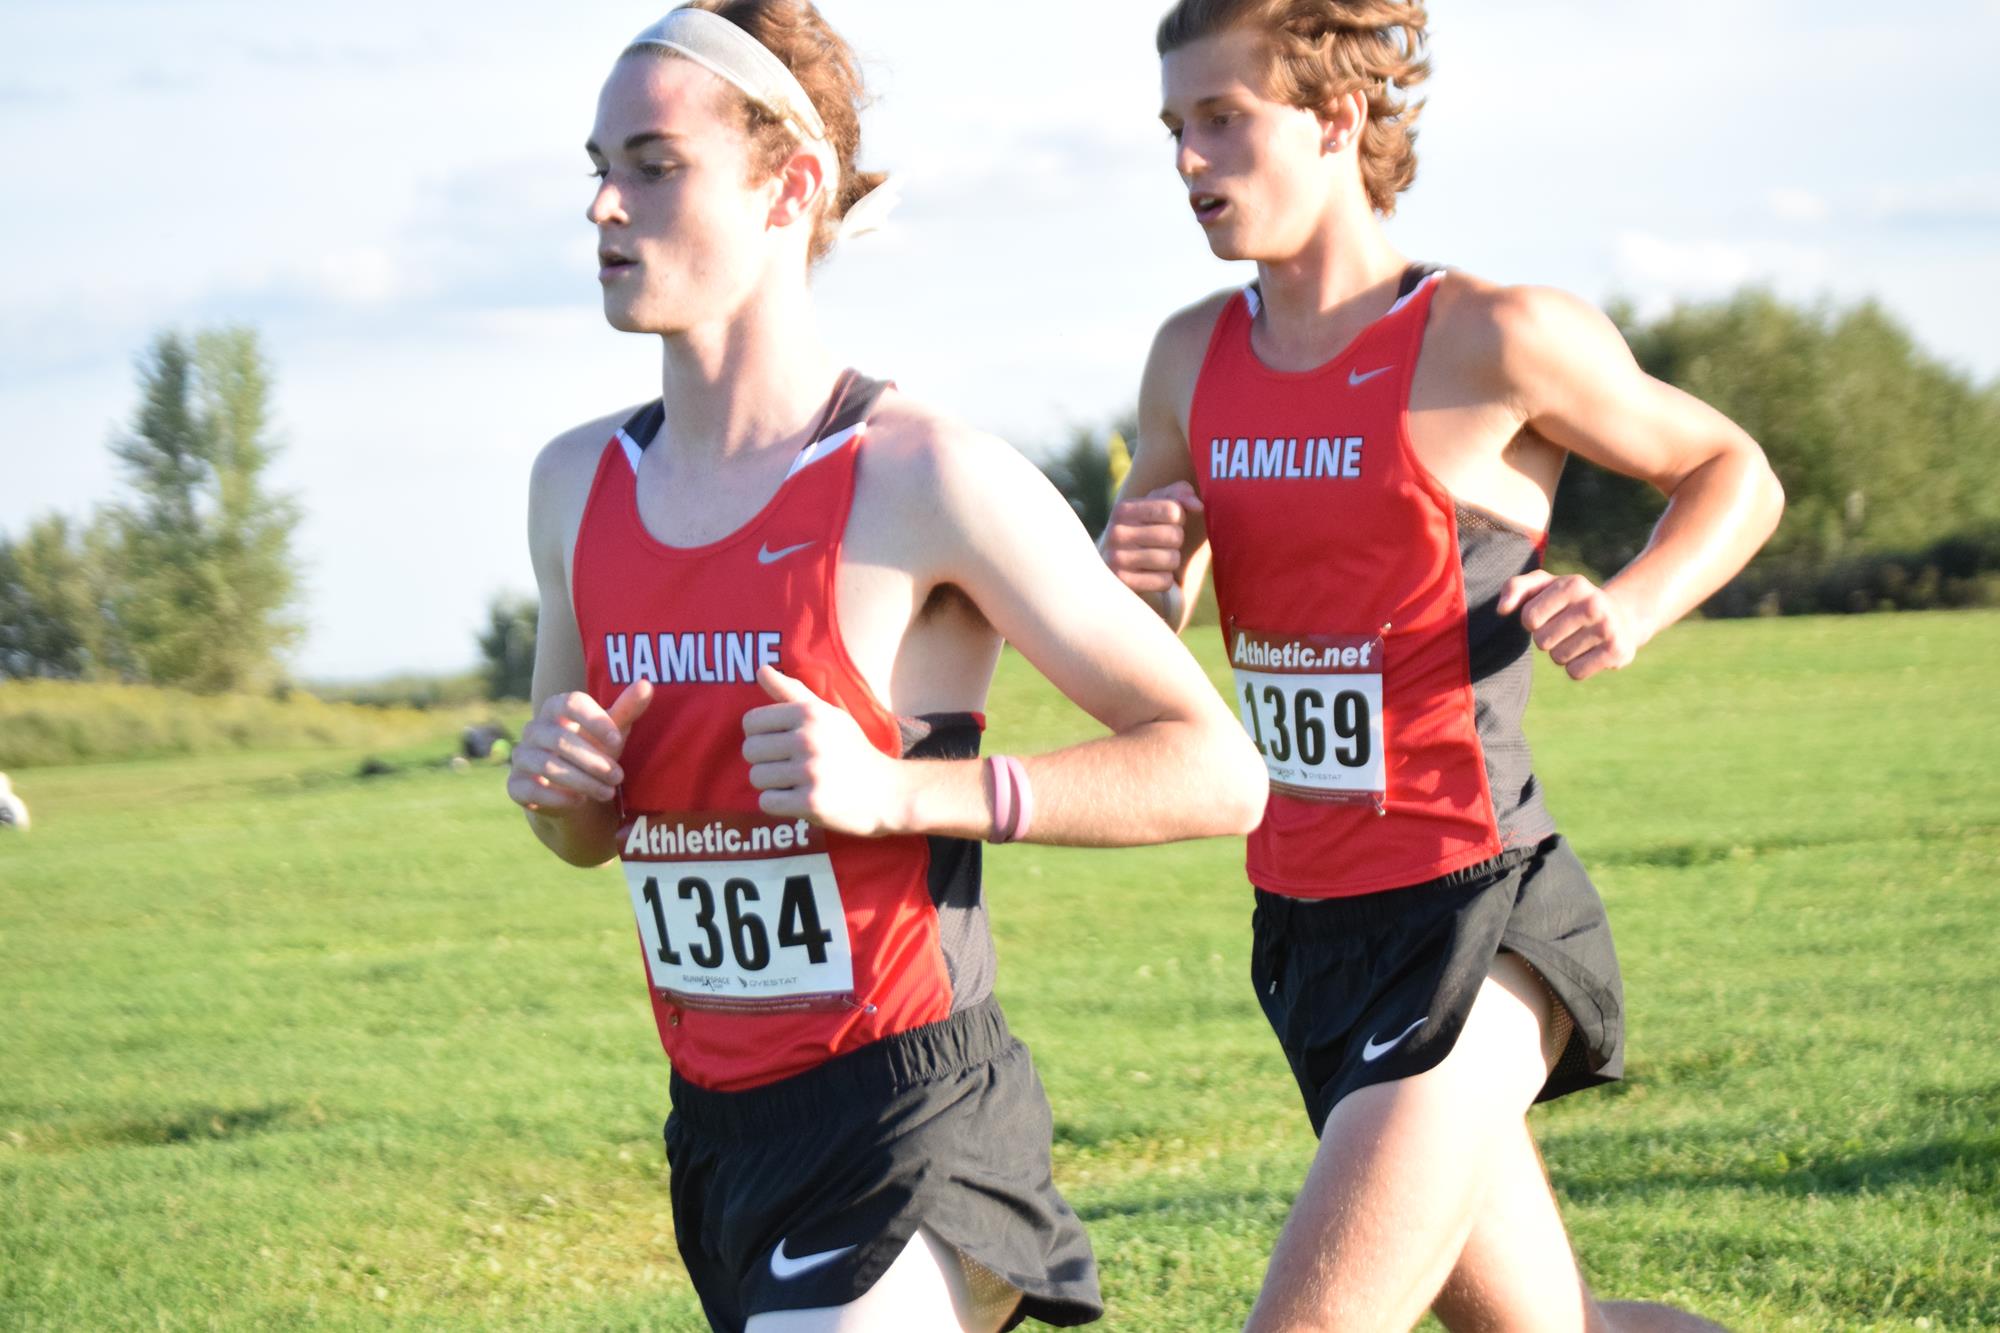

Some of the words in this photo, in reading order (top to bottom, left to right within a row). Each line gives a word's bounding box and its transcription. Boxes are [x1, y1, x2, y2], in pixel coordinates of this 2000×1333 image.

[1211, 436, 1364, 479] HAMLINE
[605, 631, 781, 684] HAMLINE
[1234, 632, 1372, 668] Athletic.net
[1244, 681, 1371, 767] 1369
[624, 815, 810, 855] Athletic.net
[642, 873, 833, 971] 1364
